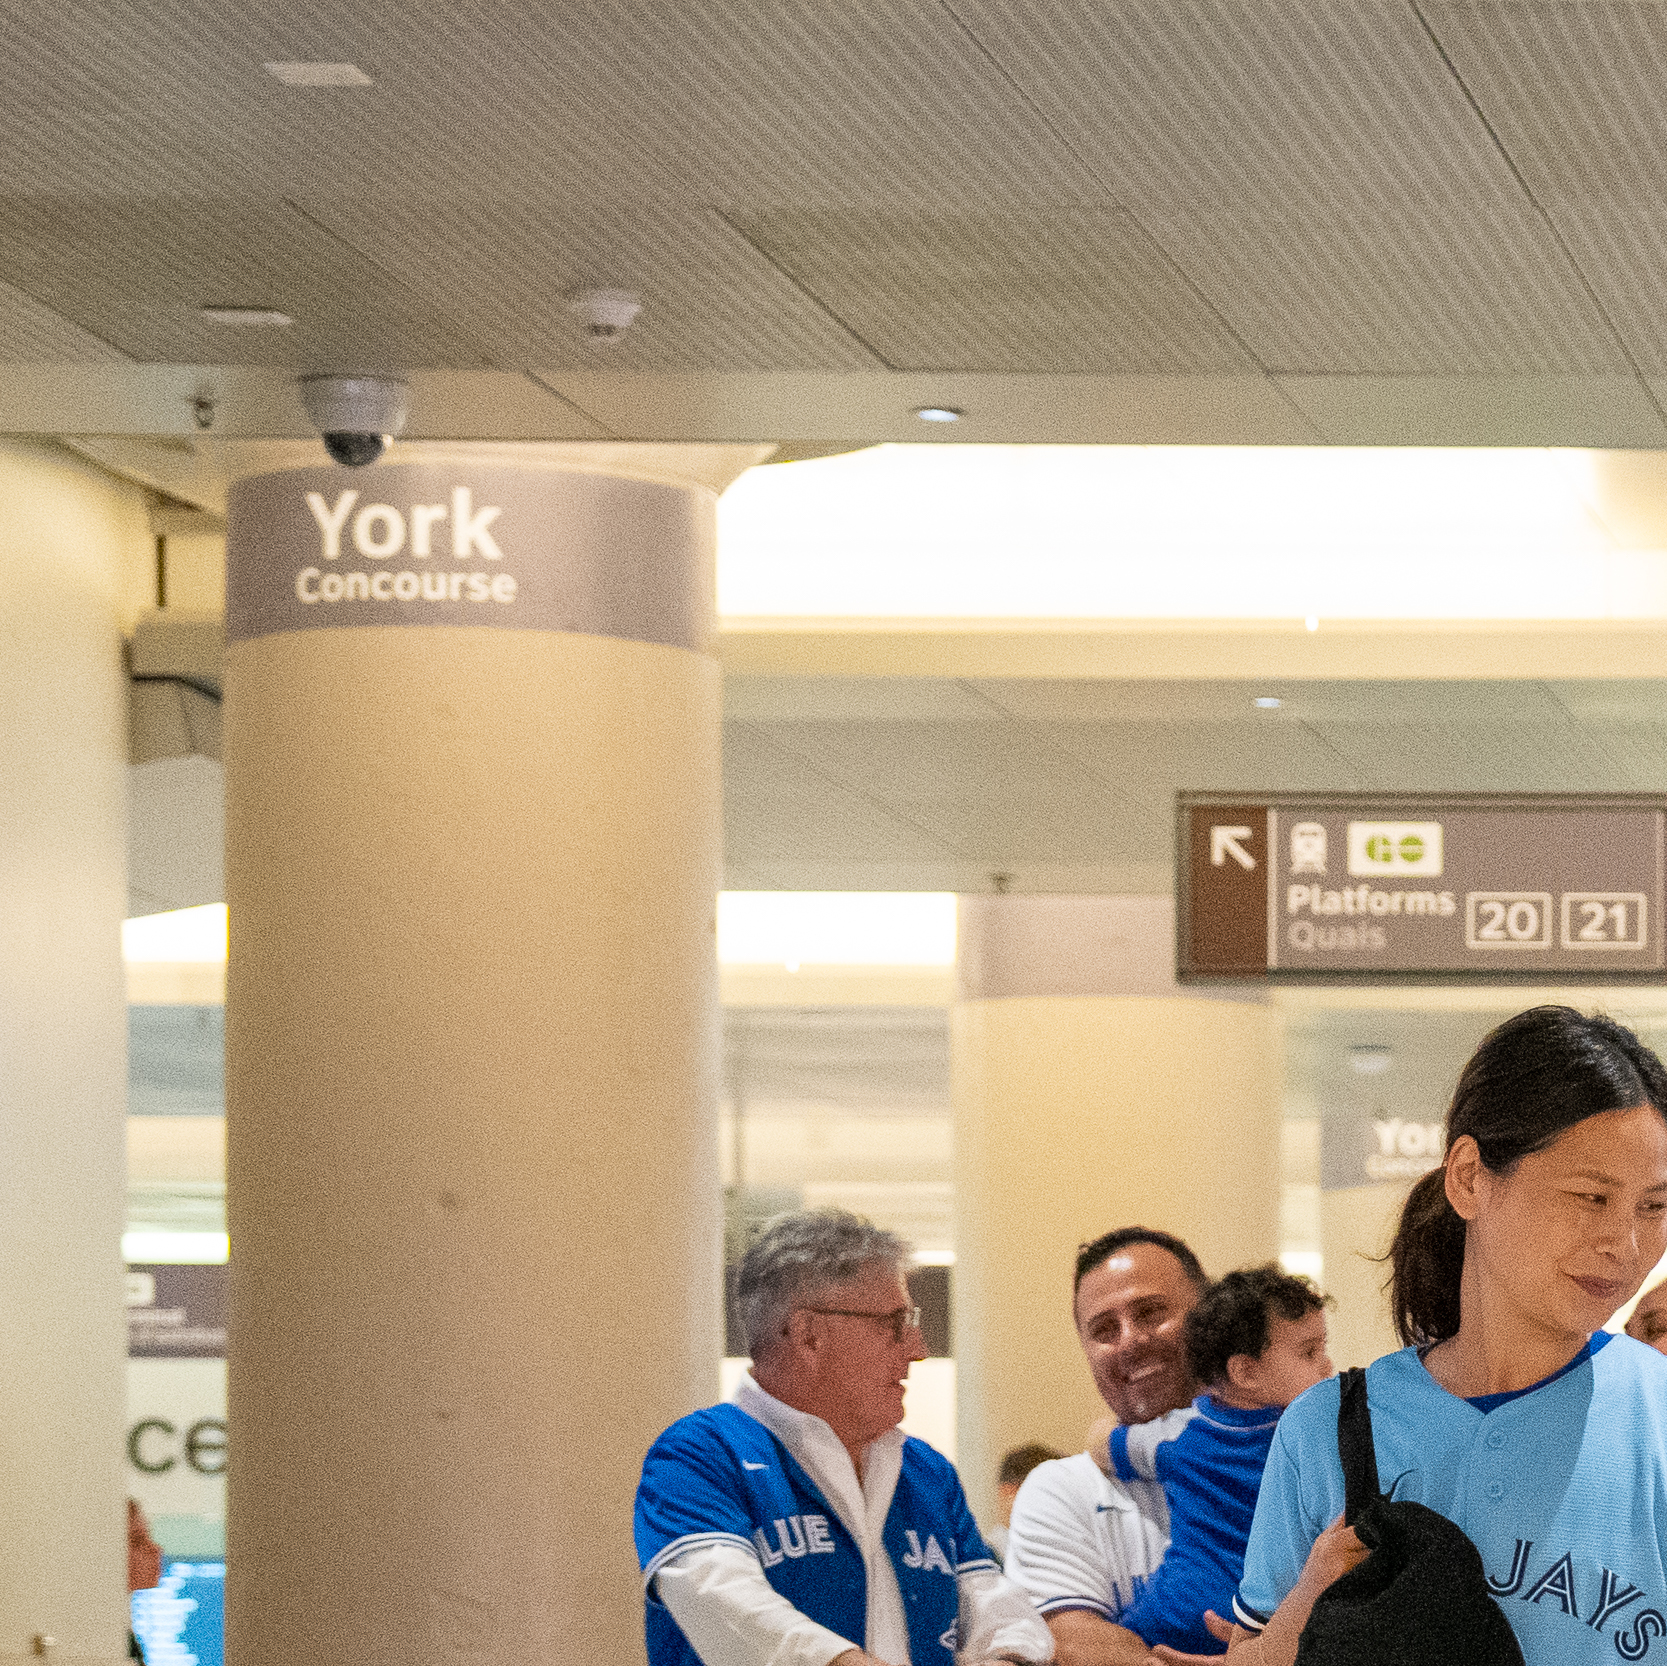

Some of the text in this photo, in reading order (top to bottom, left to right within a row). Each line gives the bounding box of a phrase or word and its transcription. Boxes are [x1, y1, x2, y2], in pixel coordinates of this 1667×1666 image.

[306, 487, 503, 561] York
[295, 567, 518, 603] Concourse
[1287, 883, 1457, 917] Platforms
[1287, 920, 1387, 951] Quais
[1478, 901, 1628, 941] 20 21
[1372, 1117, 1444, 1158] Yor
[752, 1514, 958, 1575] LUE JA
[1486, 1538, 1667, 1662] JAYS
